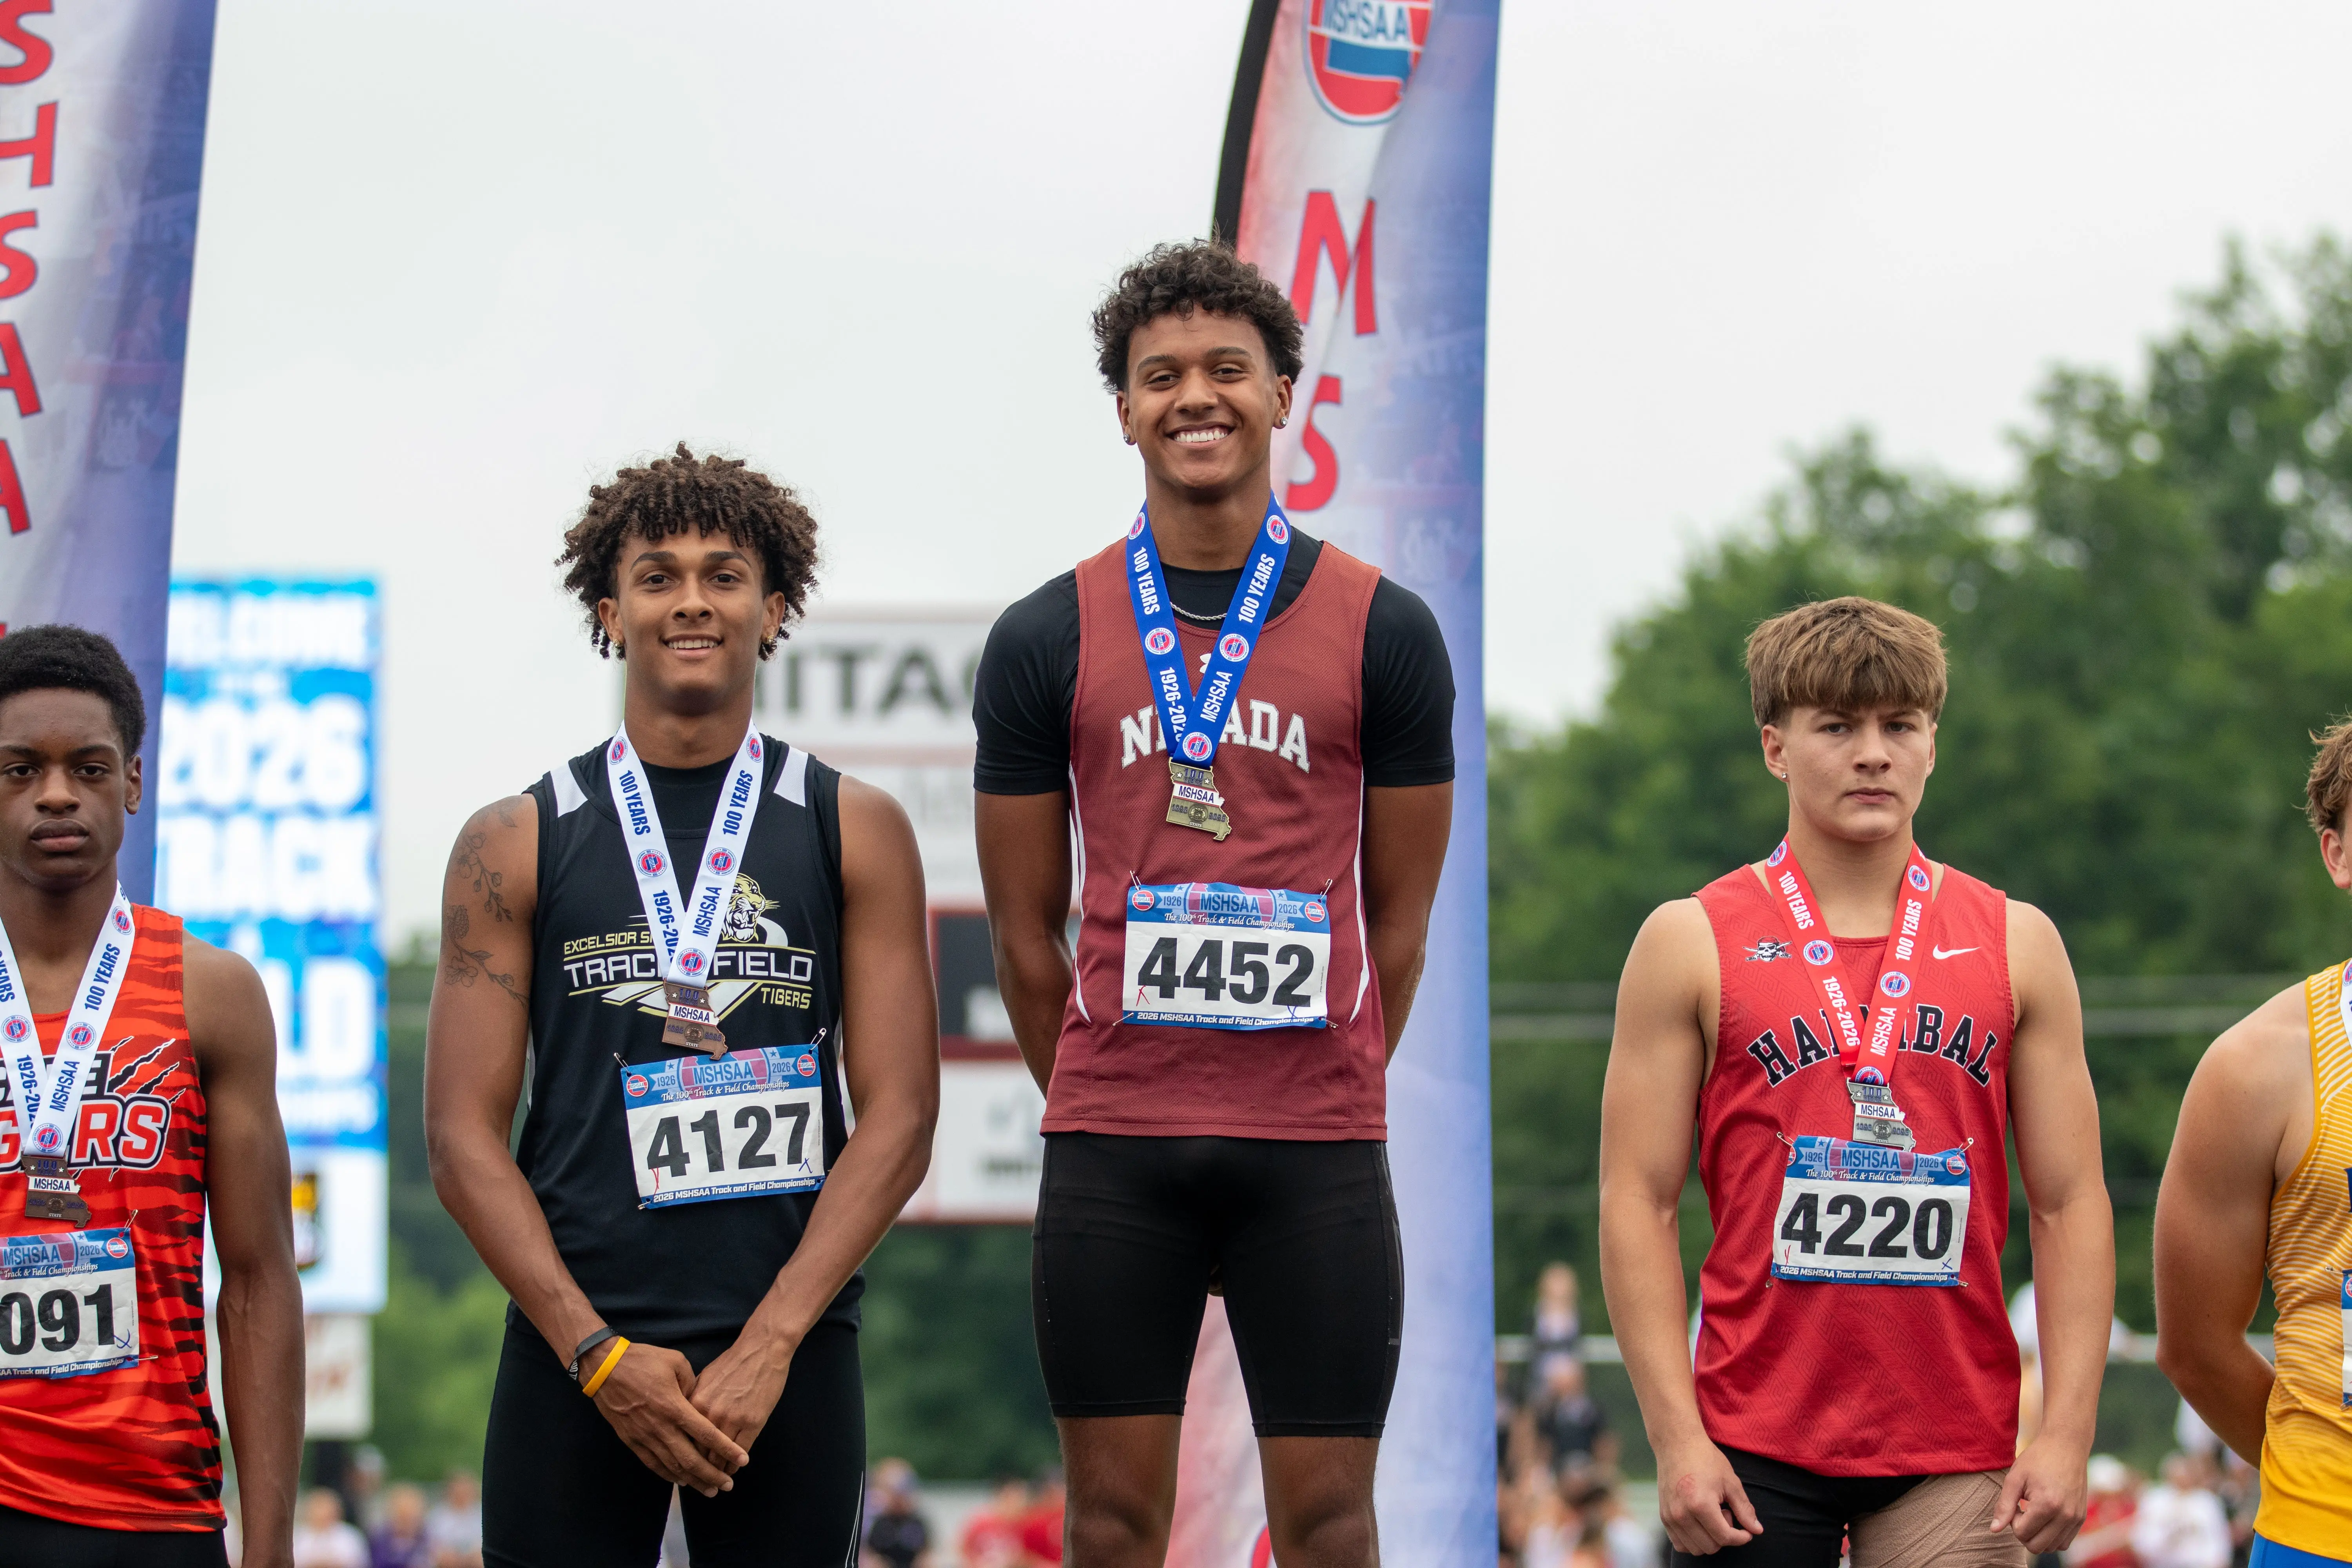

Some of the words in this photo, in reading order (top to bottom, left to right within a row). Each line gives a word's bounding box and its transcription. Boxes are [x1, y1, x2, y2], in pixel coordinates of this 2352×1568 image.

[1134, 546, 1149, 572] 100
[1247, 553, 1275, 597] YEARS
[1138, 571, 1160, 615] YEARS
[1238, 596, 1259, 624] 100
[1200, 671, 1232, 722] MSHSAA
[1120, 699, 1310, 773] NADA
[619, 770, 638, 793] 100
[1184, 768, 1204, 780] 100
[730, 770, 753, 809] YEARS
[1179, 786, 1214, 803] MSHSAA
[626, 792, 651, 835] YEARS
[722, 809, 742, 835] 100
[1171, 804, 1188, 813] 1926
[1209, 812, 1226, 822] 2026
[1779, 870, 1797, 895] 100
[693, 887, 722, 936] MSHSAA
[1163, 895, 1181, 906] 1926
[1200, 893, 1259, 913] MSHSAA
[1278, 904, 1297, 914] 2026
[1786, 893, 1814, 930] YEARS
[1165, 913, 1176, 922] The
[1198, 915, 1217, 924] Track
[1227, 916, 1245, 925] Field
[1247, 917, 1295, 931] Championships
[1901, 898, 1922, 936] YEARS
[564, 933, 639, 955] EXCELSIOR
[1895, 937, 1914, 961] 100
[93, 943, 120, 984] YEARS
[714, 951, 813, 982] FIELD
[1137, 937, 1314, 1007] 4452
[85, 985, 105, 1011] 100
[679, 988, 699, 1000] 100
[760, 987, 812, 1009] TIGERS
[674, 1006, 710, 1023] MSHSAA
[1160, 1013, 1194, 1022] MSHSAA
[1196, 1015, 1218, 1024] Track
[1235, 1017, 1253, 1025] Field
[1823, 976, 1860, 1047] 1926-2026
[1870, 1007, 1897, 1057] MSHSAA
[657, 1075, 676, 1086] 1926
[693, 1061, 753, 1084] MSHSAA
[772, 1062, 791, 1073] 2026
[50, 1061, 80, 1112] MSHSAA
[662, 1093, 674, 1102] The
[694, 1087, 714, 1097] Track
[724, 1085, 740, 1093] Field
[742, 1078, 789, 1093] Championships
[1863, 1087, 1882, 1097] 100
[1861, 1104, 1896, 1118] MSHSAA
[647, 1102, 810, 1177] 4127
[37, 1160, 57, 1170] 100
[1805, 1151, 1822, 1162] 1926
[1842, 1149, 1899, 1169] MSHSAA
[1919, 1158, 1938, 1167] 2026
[34, 1178, 71, 1191] MSHSAA
[653, 1193, 674, 1203] 2026
[675, 1189, 710, 1199] MSHSAA
[711, 1187, 731, 1195] Track
[733, 1184, 747, 1192] and
[748, 1182, 766, 1191] Field
[767, 1178, 815, 1190] Championships
[1806, 1169, 1817, 1177] The
[1838, 1171, 1858, 1179] Track
[1868, 1172, 1885, 1181] Field
[1886, 1174, 1935, 1187] Championships
[1781, 1192, 1953, 1260] 4220
[3, 1245, 60, 1265] MSHSAA
[80, 1245, 100, 1256] 2026
[32, 1267, 47, 1276] Field
[48, 1261, 98, 1276] Championships
[1780, 1266, 1799, 1275] 2026
[1800, 1268, 1835, 1278] MSHSAA
[1893, 1272, 1947, 1282] Championships
[51, 1365, 69, 1374] Field
[70, 1358, 124, 1371] Championships
